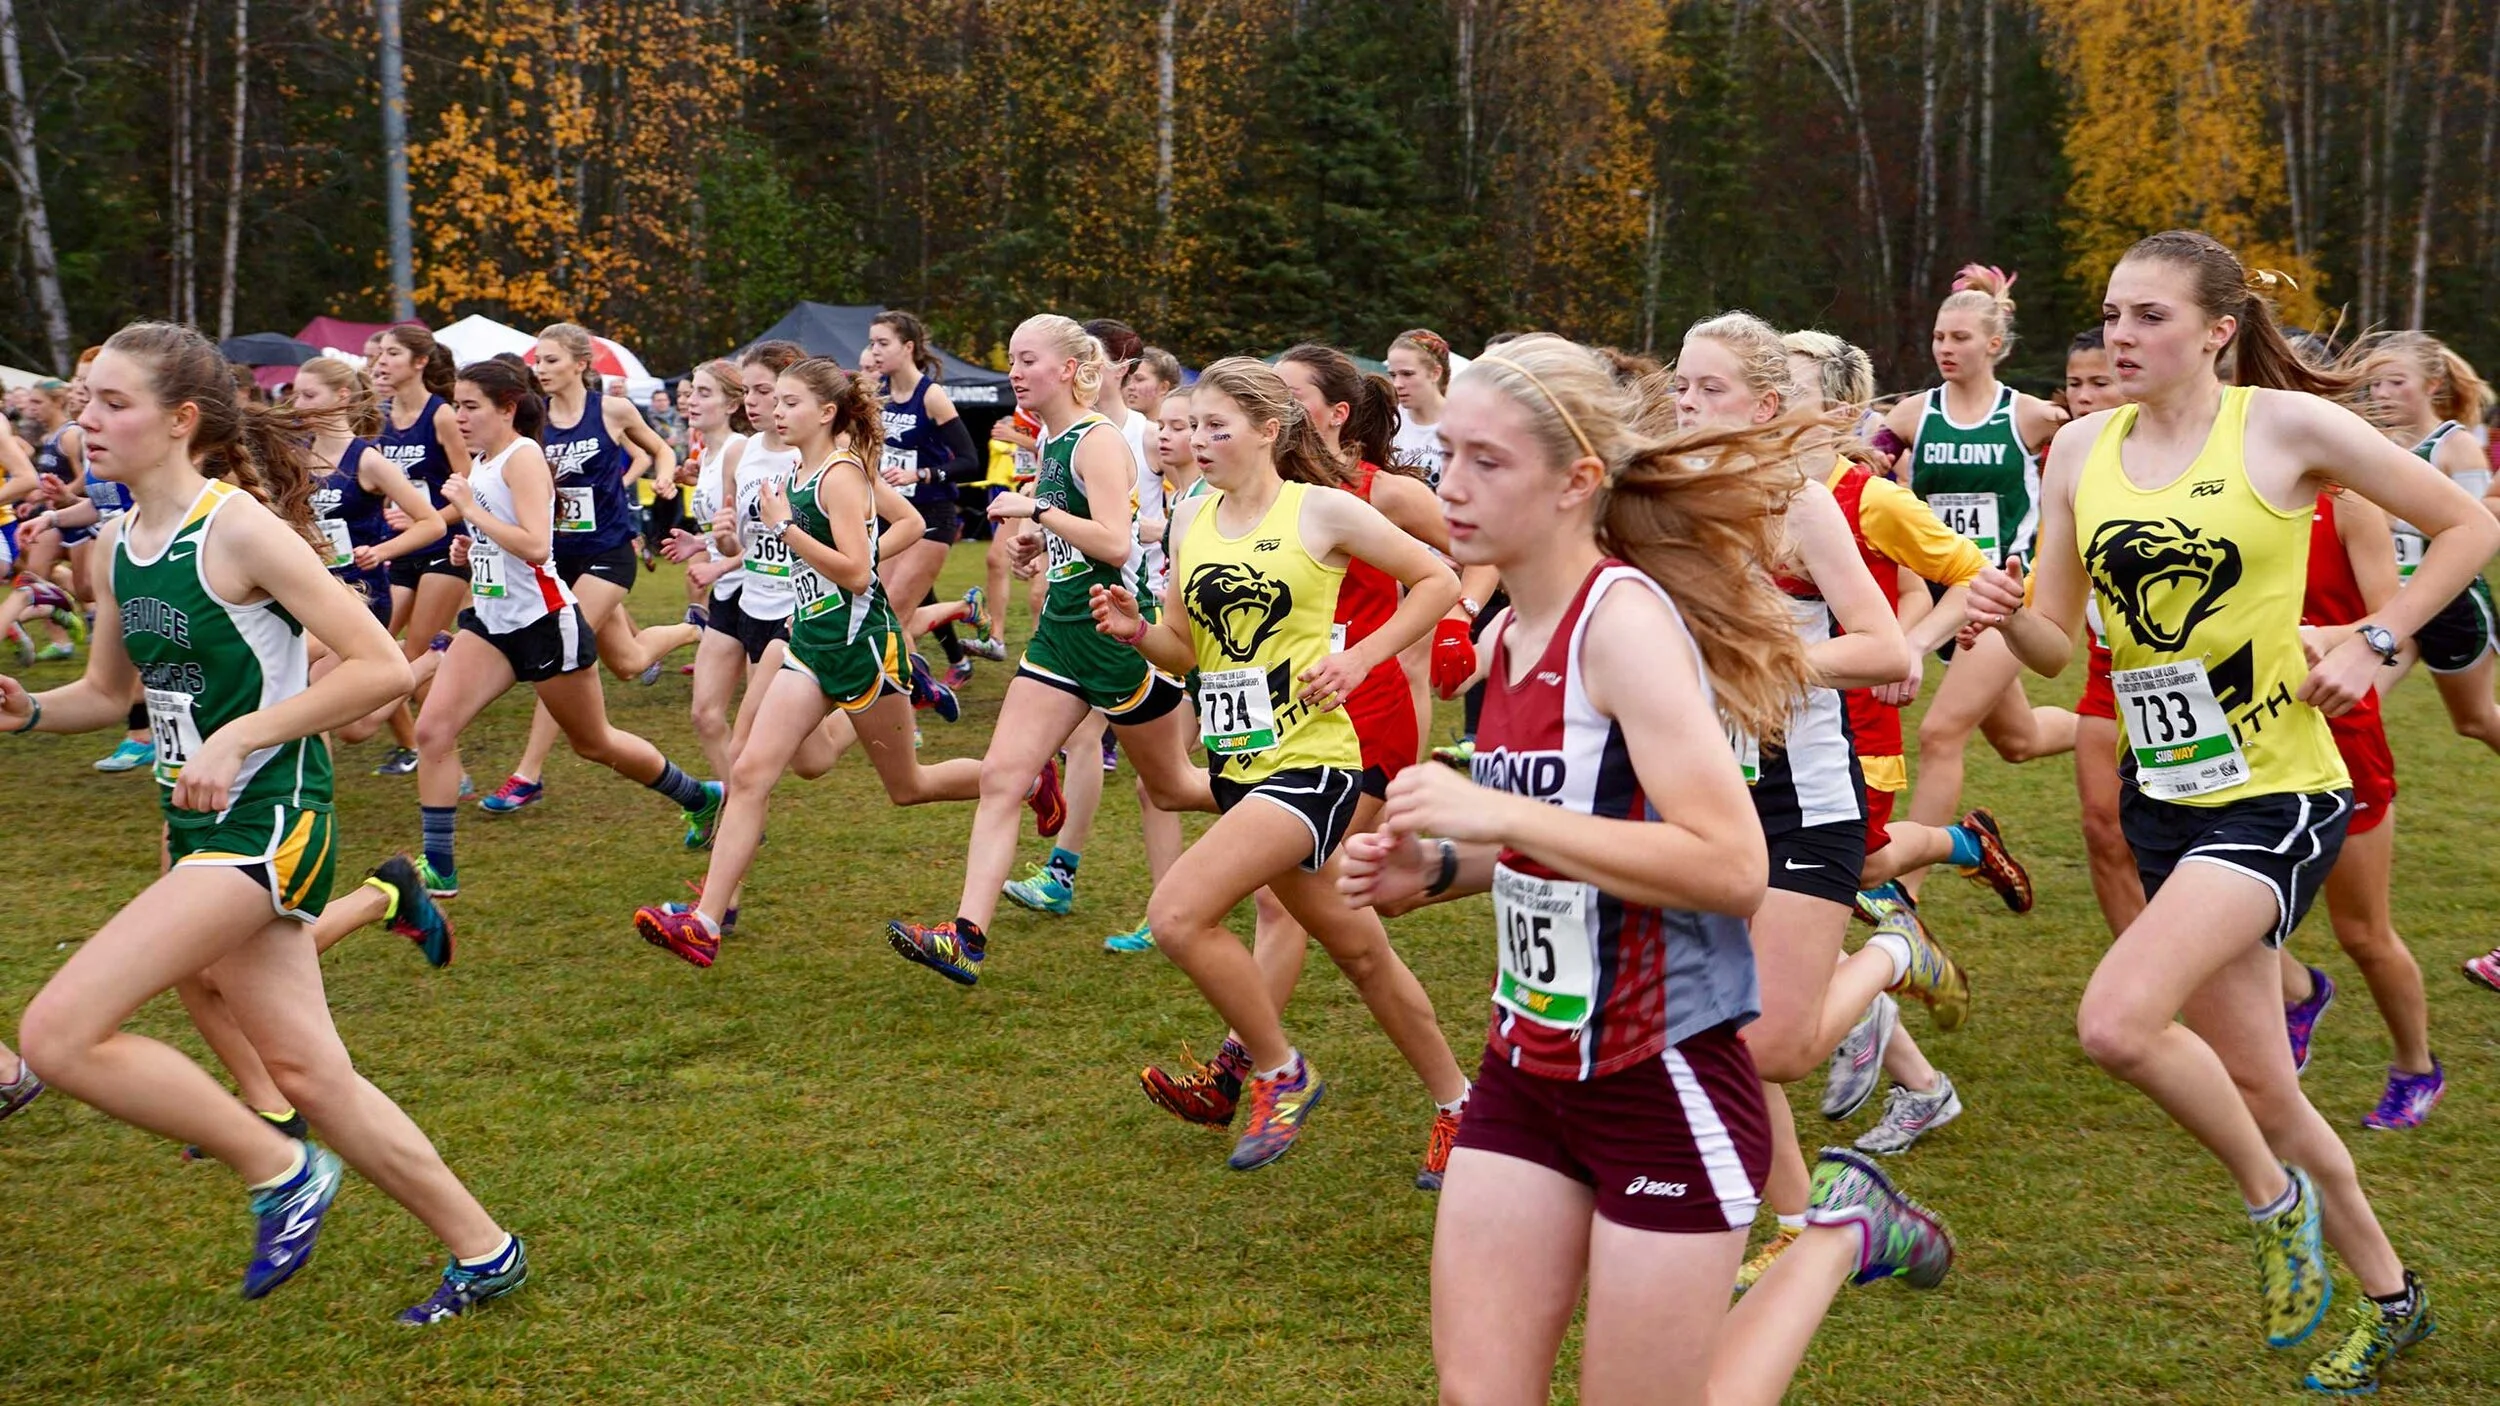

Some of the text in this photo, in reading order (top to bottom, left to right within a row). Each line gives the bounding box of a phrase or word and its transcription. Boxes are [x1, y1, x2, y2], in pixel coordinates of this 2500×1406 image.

[384, 445, 425, 458] STARS
[545, 437, 600, 457] STARS
[1923, 442, 2007, 465] COLONY
[563, 500, 581, 519] 23
[1944, 508, 1979, 535] 464
[121, 597, 192, 649] ERVICE
[1206, 691, 1252, 733] 734
[2131, 691, 2197, 744] 733
[1218, 736, 1250, 749] SUBWAY
[2155, 744, 2199, 763] SUBWAY
[1507, 906, 1556, 983] 485
